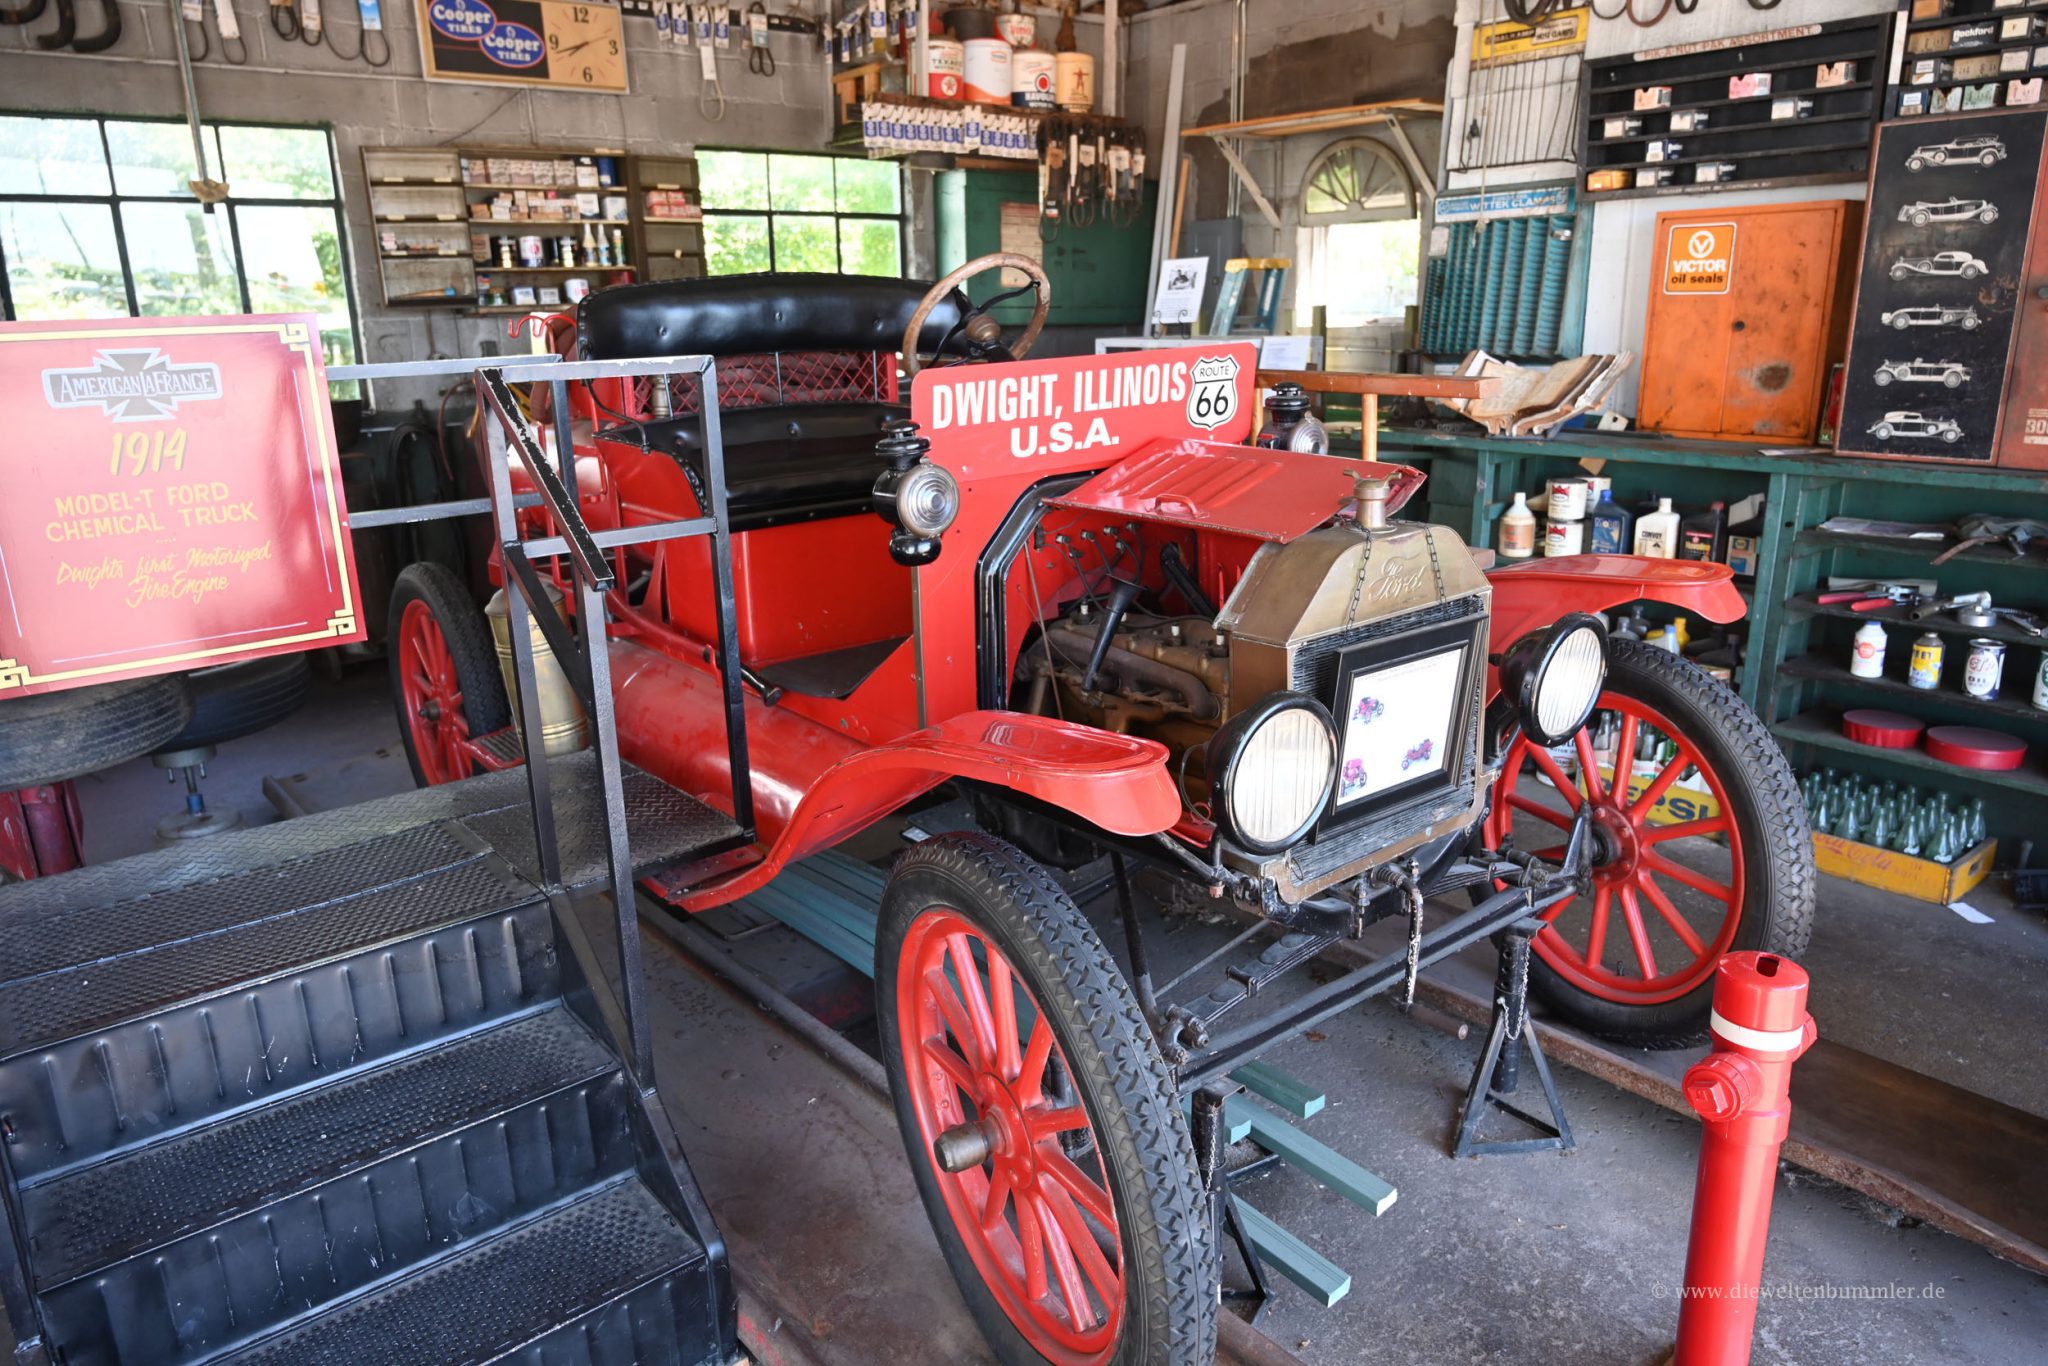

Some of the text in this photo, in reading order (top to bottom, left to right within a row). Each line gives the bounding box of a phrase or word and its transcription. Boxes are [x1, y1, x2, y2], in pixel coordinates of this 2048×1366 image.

[433, 4, 491, 25] Cooper
[572, 6, 590, 24] 12
[447, 23, 483, 35] TIRES
[1729, 25, 1813, 48] ASSORTMENT
[484, 33, 541, 52] Cooper
[549, 35, 560, 50] 9
[609, 40, 619, 56] 3
[497, 50, 531, 62] TIRES
[582, 67, 593, 83] 6
[1469, 200, 1509, 212] WTTEK
[1672, 259, 1727, 273] VICTOR
[1671, 273, 1724, 284] oil seals
[1199, 365, 1230, 378] ROUTE
[931, 361, 1188, 430] DWIGHT, ILLINOIS
[1195, 384, 1229, 418] 66
[2025, 418, 2048, 435] 30
[1009, 417, 1120, 459] U.S.A.
[109, 427, 188, 477] 1914
[54, 481, 229, 518] MODEL-T FORD
[46, 501, 259, 542] CHEMICAL TRUCK
[125, 569, 230, 608] Fire Engine
